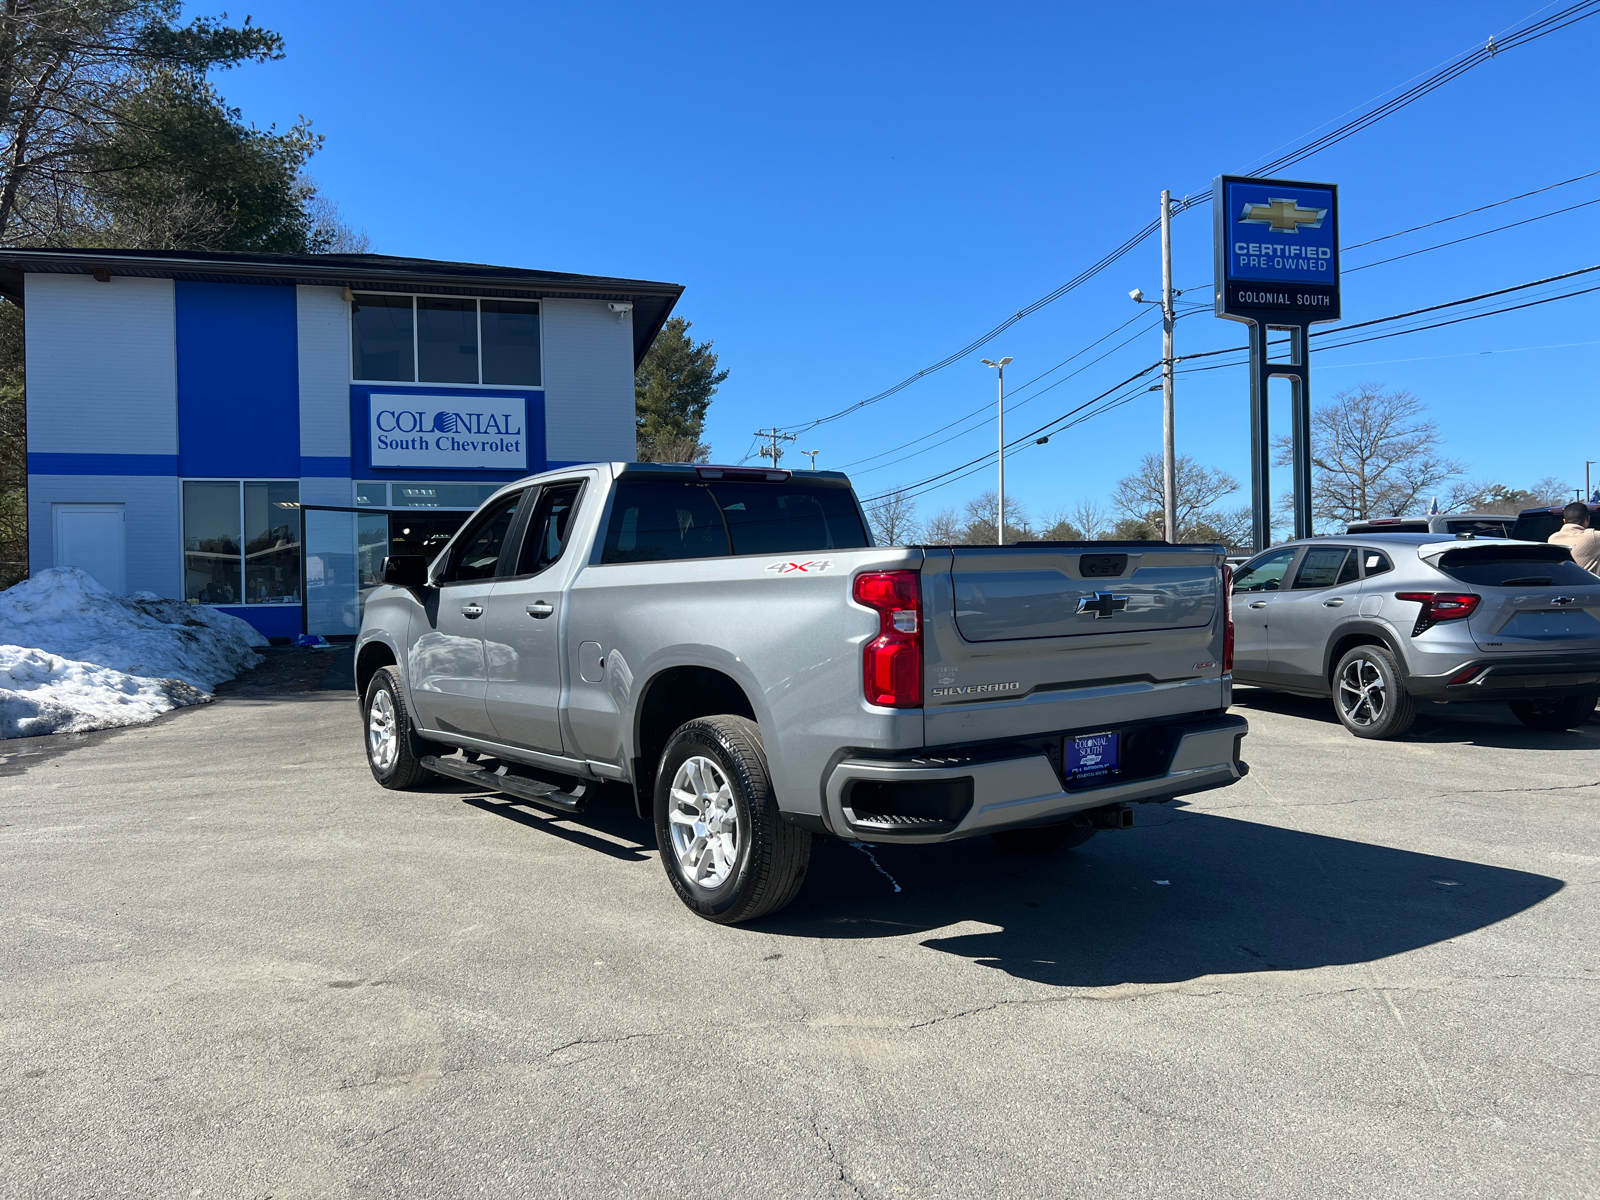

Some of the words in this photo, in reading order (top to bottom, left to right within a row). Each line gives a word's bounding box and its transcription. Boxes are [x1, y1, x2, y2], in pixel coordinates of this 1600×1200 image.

[1234, 242, 1331, 259] CERTIFIED
[1240, 256, 1327, 271] PRE-OWNED
[1238, 291, 1291, 305] COLONIAL
[1297, 294, 1330, 306] SOUTH
[376, 410, 521, 435] COLONIAL
[377, 434, 429, 451] South
[435, 436, 521, 452] Chevrolet
[932, 681, 1020, 697] SILVERADO
[1075, 737, 1108, 749] COLONIAL
[1079, 746, 1103, 756] SOUTH
